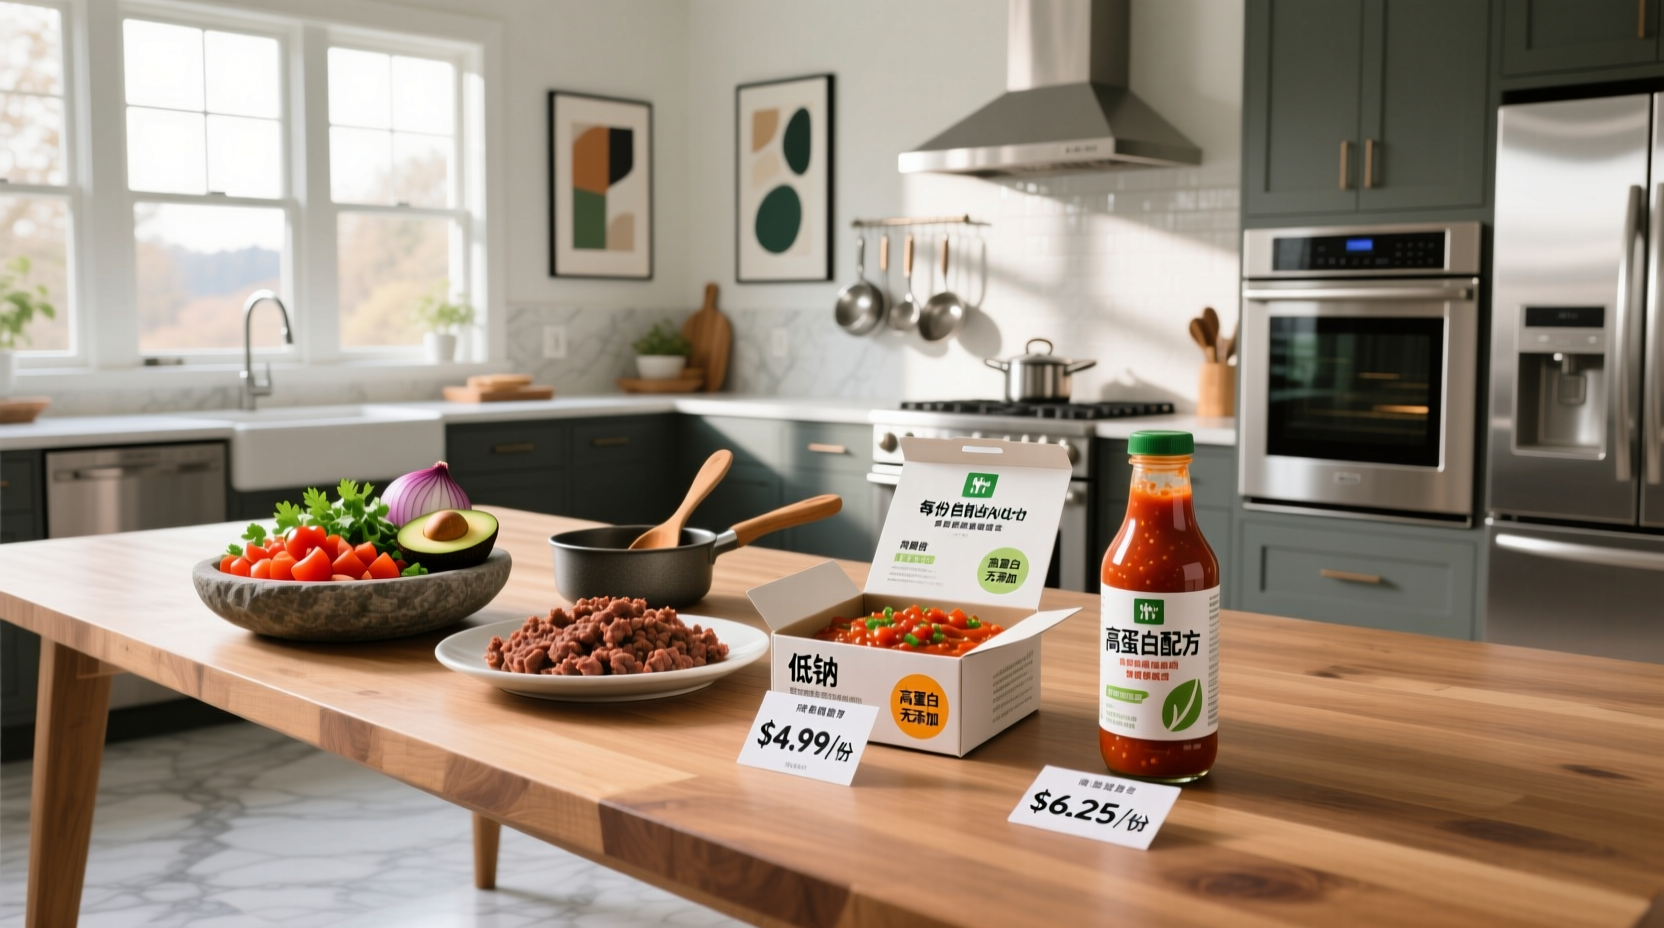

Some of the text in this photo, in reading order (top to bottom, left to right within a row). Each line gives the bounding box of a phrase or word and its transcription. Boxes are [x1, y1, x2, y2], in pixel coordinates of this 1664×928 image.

[1105, 625, 1201, 656] 高蛋白配方
[788, 653, 838, 687] 低钠
[899, 690, 939, 708] 高蛋白
[757, 719, 854, 762] $4.99/份
[1030, 789, 1149, 832] $6.25/份
